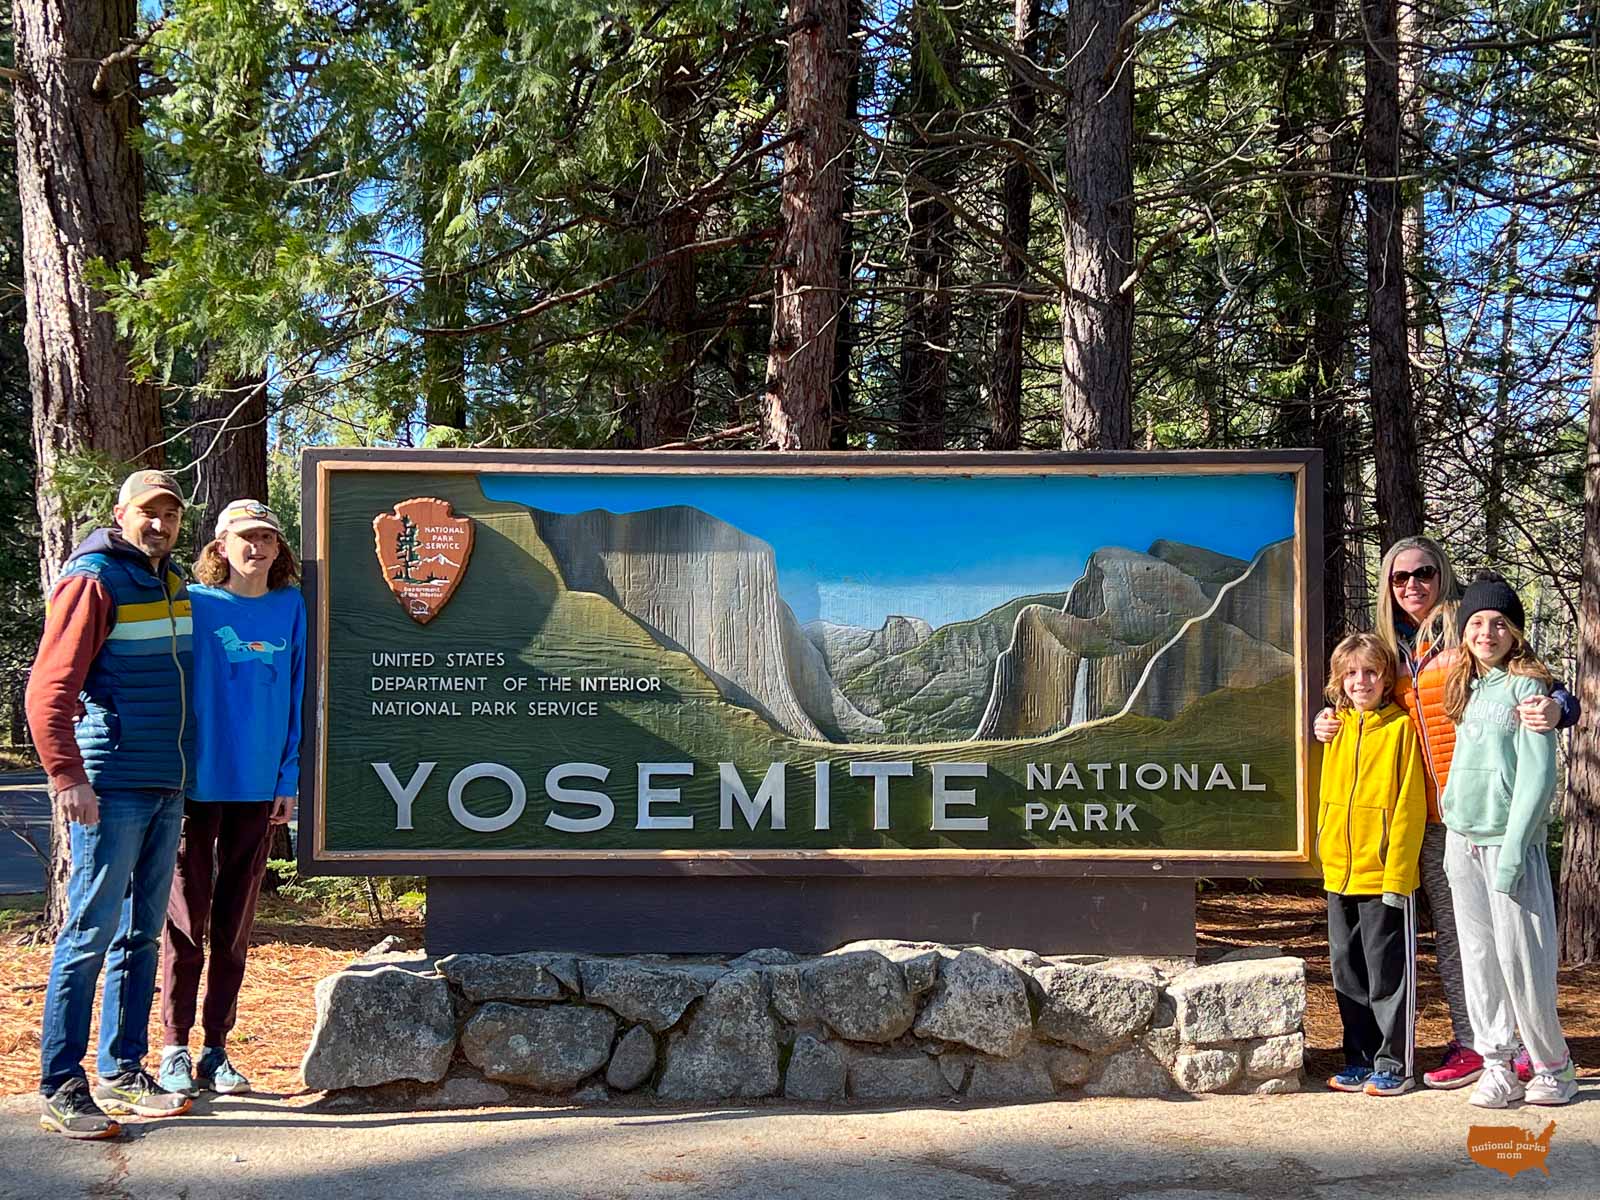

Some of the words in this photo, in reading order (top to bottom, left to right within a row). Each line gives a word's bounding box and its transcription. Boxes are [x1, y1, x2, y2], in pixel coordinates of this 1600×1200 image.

[371, 652, 434, 667] UNITED
[446, 652, 505, 667] STATES
[371, 676, 488, 691] DEPARTMENT
[503, 676, 527, 691] OF
[538, 677, 571, 691] THE
[580, 676, 661, 691] INTERIOR
[371, 701, 461, 716] NATIONAL
[471, 701, 517, 716] PARK
[527, 701, 598, 716] SERVICE
[1026, 762, 1267, 791] NATIONAL
[371, 762, 988, 833] YOSEMITE
[1025, 803, 1140, 832] PARK
